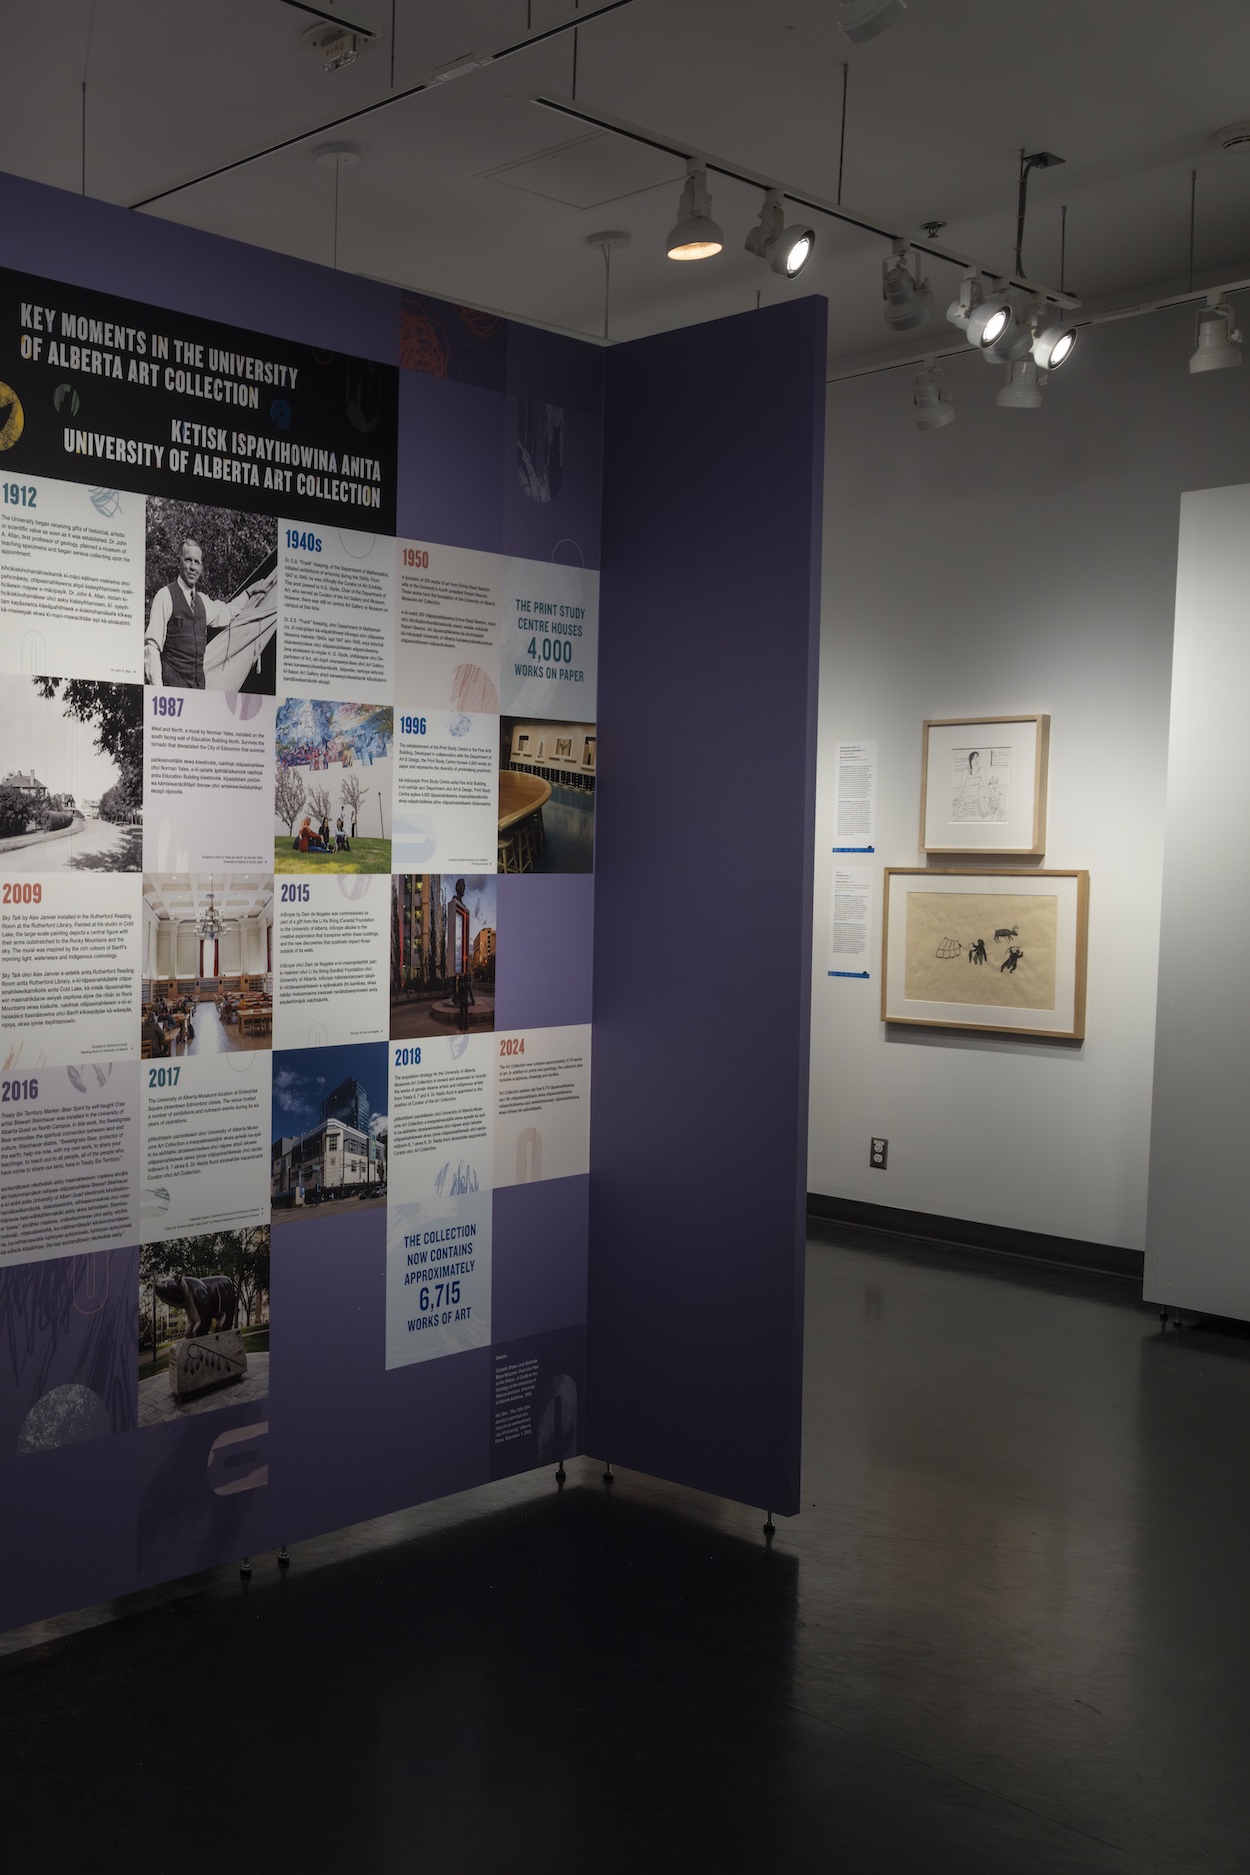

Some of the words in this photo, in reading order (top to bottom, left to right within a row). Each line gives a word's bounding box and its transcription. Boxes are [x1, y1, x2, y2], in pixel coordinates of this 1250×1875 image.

[21, 302, 55, 333] KEY
[61, 312, 146, 355] MOMENTS
[152, 334, 168, 359] IN
[173, 339, 203, 367] THE
[209, 348, 297, 389] UNIVERSITY
[20, 333, 42, 362] OF
[48, 340, 123, 379] ALBERTA
[128, 358, 159, 387] ART
[164, 366, 258, 409] COLLECTION
[171, 419, 226, 452] KETISK
[232, 431, 337, 473] ISPAYIHOWINA
[341, 454, 380, 481] ANITA
[64, 427, 164, 469] UNIVERSITY
[169, 448, 188, 473] OF
[193, 452, 259, 486] ALBERTA
[263, 466, 292, 492] ART
[296, 472, 380, 508] COLLECTION
[2, 482, 36, 508] 1912
[0, 513, 10, 521] The
[11, 515, 35, 526] University
[34, 518, 50, 528] began
[50, 521, 71, 531] receiving
[71, 524, 82, 533] gifts
[109, 530, 125, 538] artistic
[285, 529, 321, 552] 1940s
[402, 547, 428, 569] 1950
[515, 598, 531, 612] THE
[533, 601, 557, 615] PRINT
[559, 604, 585, 620] STUDY
[517, 617, 549, 632] CENTRE
[551, 621, 583, 637] HOUSES
[527, 635, 572, 666] 4,000
[514, 663, 543, 678] WORKS
[545, 666, 557, 679] ON
[559, 668, 584, 682] PAPER
[152, 695, 183, 717] 1987
[400, 715, 426, 734] 1996
[163, 733, 176, 741] facing
[211, 736, 229, 744] Building
[2, 883, 41, 904] 2009
[281, 884, 309, 902] 2015
[1, 914, 11, 922] Sky
[113, 912, 132, 920] Reading
[395, 1047, 421, 1066] 2018
[500, 1038, 524, 1056] 2024
[149, 1066, 180, 1088] 2017
[1, 1078, 38, 1101] 2016
[156, 1095, 177, 1104] University
[238, 1087, 258, 1096] Enterprise
[1, 1111, 15, 1120] Treaty
[23, 1108, 43, 1117] Territory
[72, 1104, 85, 1113] Spirit
[91, 1101, 114, 1111] self-taught
[403, 1233, 420, 1248] THE
[423, 1223, 476, 1244] COLLECTION
[407, 1251, 427, 1266] NOW
[430, 1242, 472, 1261] CONTAINS
[404, 1260, 474, 1285] APPROXIMATELY
[419, 1280, 460, 1314] 6,715
[407, 1314, 438, 1332] WORKS
[441, 1310, 452, 1325] OF
[454, 1307, 471, 1321] ART
